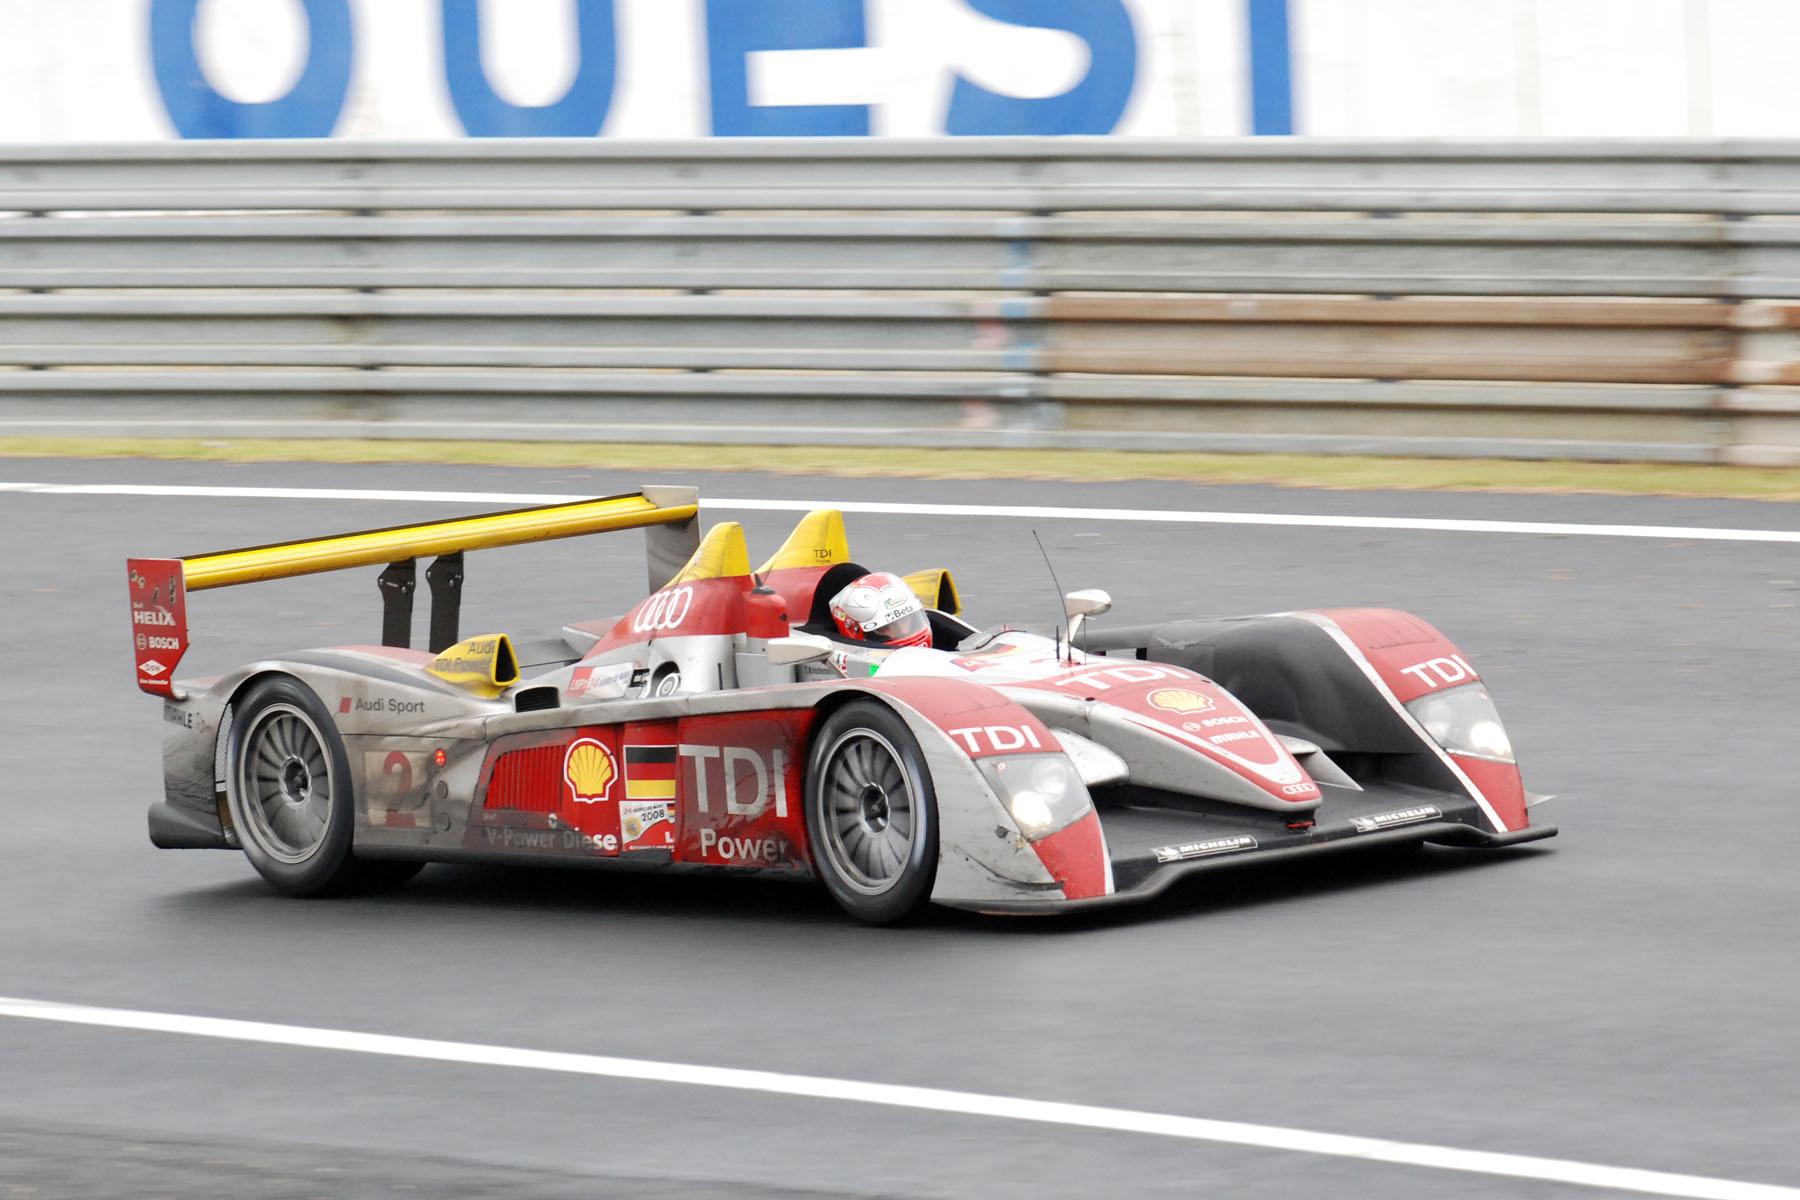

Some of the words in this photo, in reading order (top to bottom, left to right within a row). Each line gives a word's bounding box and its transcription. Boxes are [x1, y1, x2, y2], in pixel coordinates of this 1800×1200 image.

[814, 549, 832, 559] TDI
[134, 611, 176, 626] HELIX
[893, 605, 914, 618] Beta
[149, 636, 179, 650] BOSCH
[467, 640, 497, 655] Audi
[1055, 666, 1190, 690] TDI
[1401, 654, 1477, 687] TDI
[355, 698, 385, 712] Audi
[388, 698, 425, 716] Sport
[1201, 716, 1248, 727] BOSCH
[949, 725, 1041, 753] TDI
[678, 744, 788, 818] TDI
[641, 809, 665, 822] 2008
[1374, 806, 1436, 822] MICHELIN
[700, 828, 789, 862] Power
[1179, 836, 1250, 852] MICHELIN
